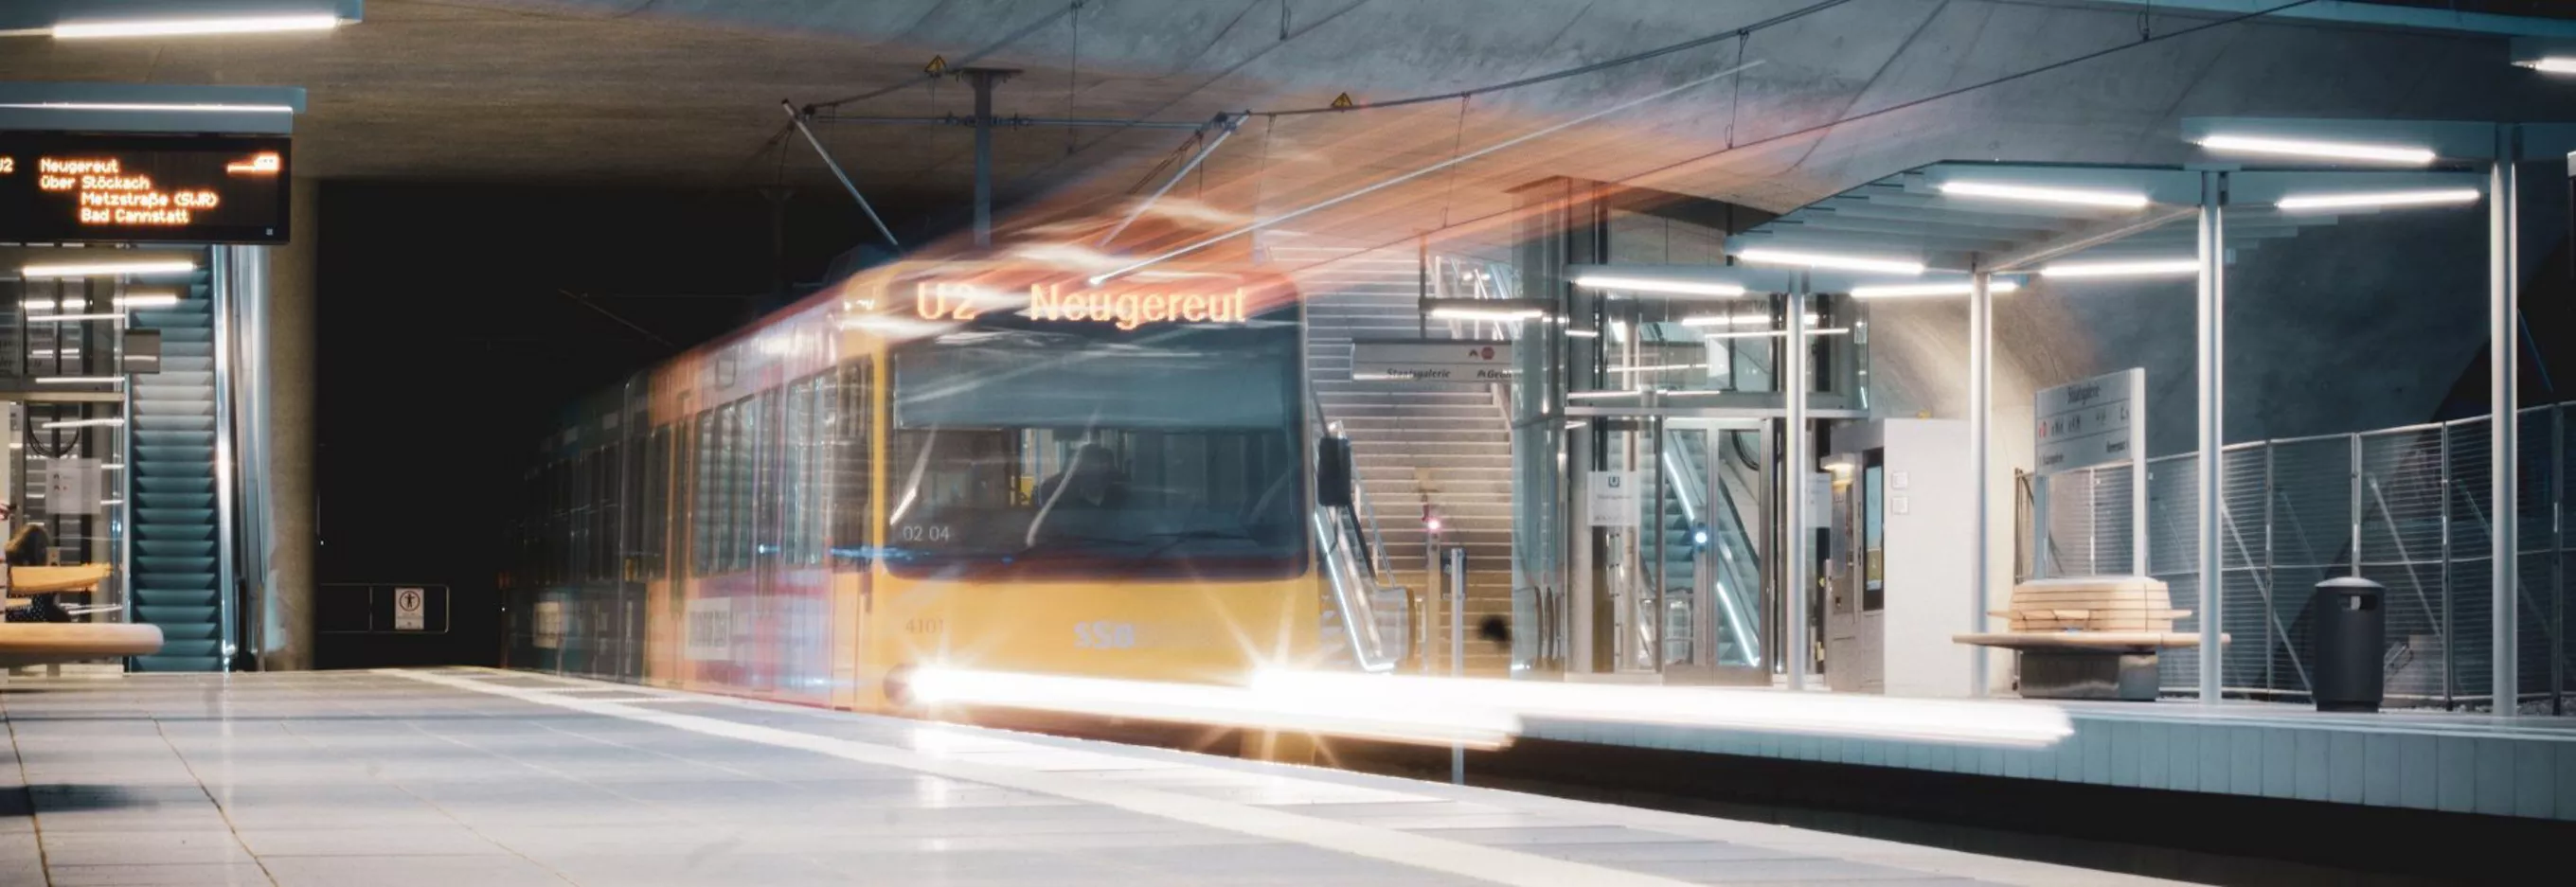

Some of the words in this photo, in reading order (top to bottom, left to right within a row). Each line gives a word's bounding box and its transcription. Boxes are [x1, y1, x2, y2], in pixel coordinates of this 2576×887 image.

[40, 157, 118, 174] Neugereut
[81, 175, 150, 189] Stöckach
[80, 191, 169, 208] Metzstraße
[173, 191, 218, 207] (SWR)
[80, 208, 109, 223] Bad
[115, 208, 189, 223] Cannstatt
[917, 282, 975, 321] U2
[1029, 283, 1247, 330] Neugereut
[903, 525, 923, 541] 02
[928, 525, 950, 541] 04
